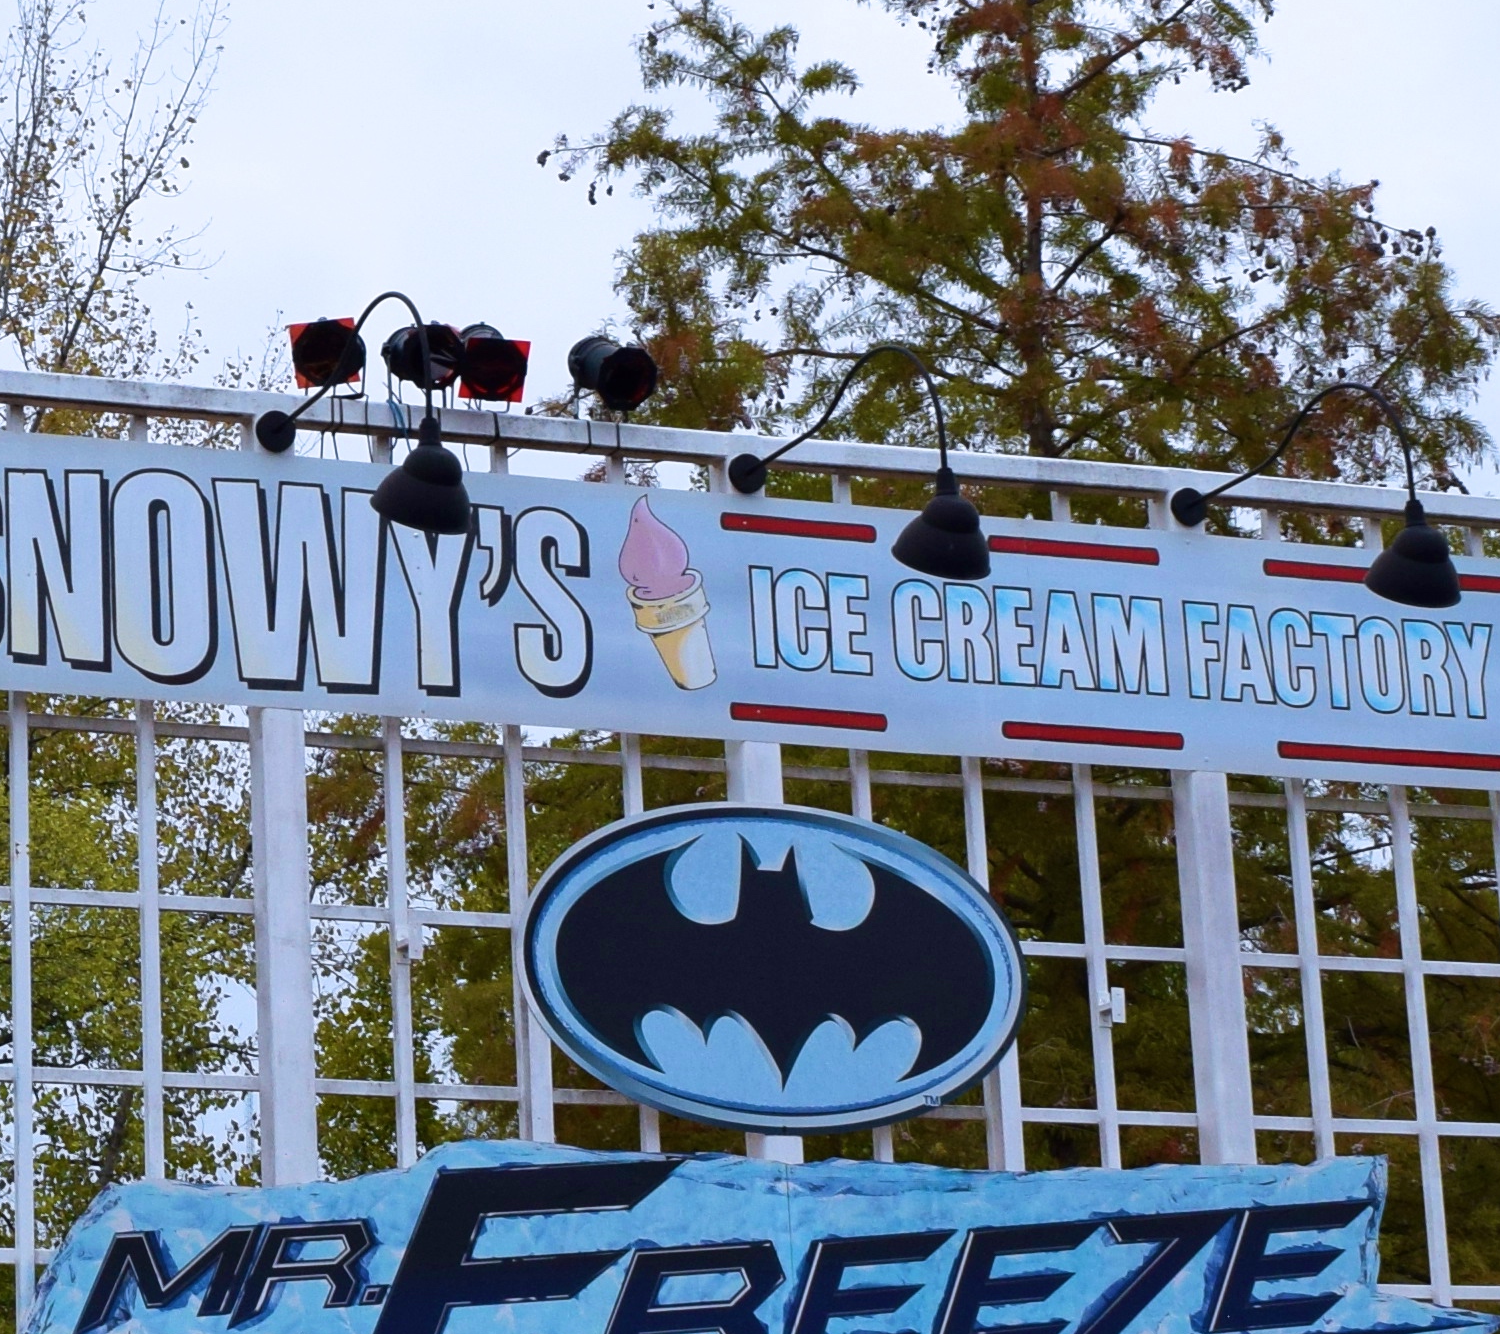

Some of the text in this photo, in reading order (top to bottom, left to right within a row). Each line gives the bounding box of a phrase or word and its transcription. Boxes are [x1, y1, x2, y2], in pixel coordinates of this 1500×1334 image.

[748, 563, 874, 677] ICE
[891, 577, 1169, 697] CREAM
[1182, 600, 1494, 720] FACTORY
